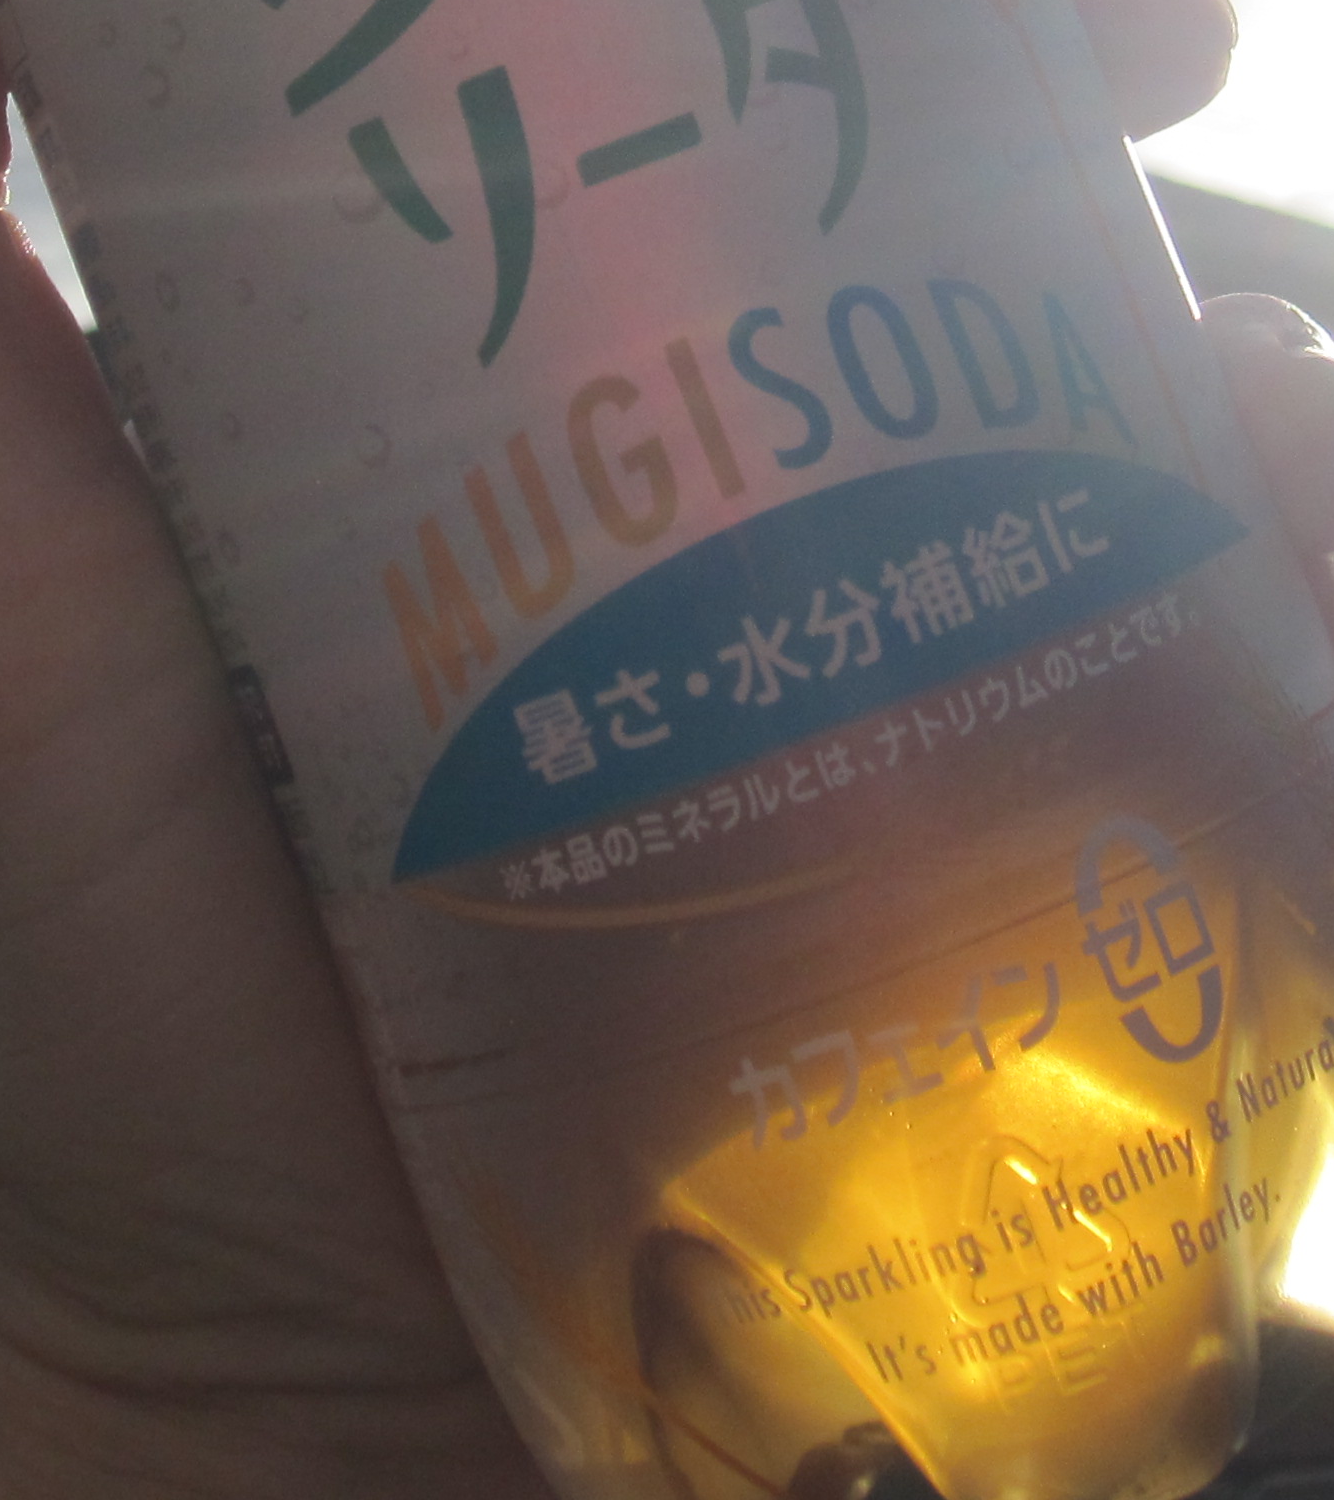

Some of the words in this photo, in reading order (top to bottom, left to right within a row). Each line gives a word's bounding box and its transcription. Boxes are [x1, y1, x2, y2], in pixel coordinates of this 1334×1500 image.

[512, 489, 1109, 786] 暑さ・水分補給に
[1080, 894, 1216, 1004] ゼロ
[783, 1231, 986, 1319] Sparkling
[991, 1209, 1033, 1254] is
[1042, 1128, 1198, 1231] Healthy
[1205, 1101, 1231, 1143] &
[866, 1336, 938, 1384] It's
[949, 1293, 1064, 1366] made
[1078, 1241, 1164, 1317] with
[1171, 1176, 1281, 1268] Barley.
